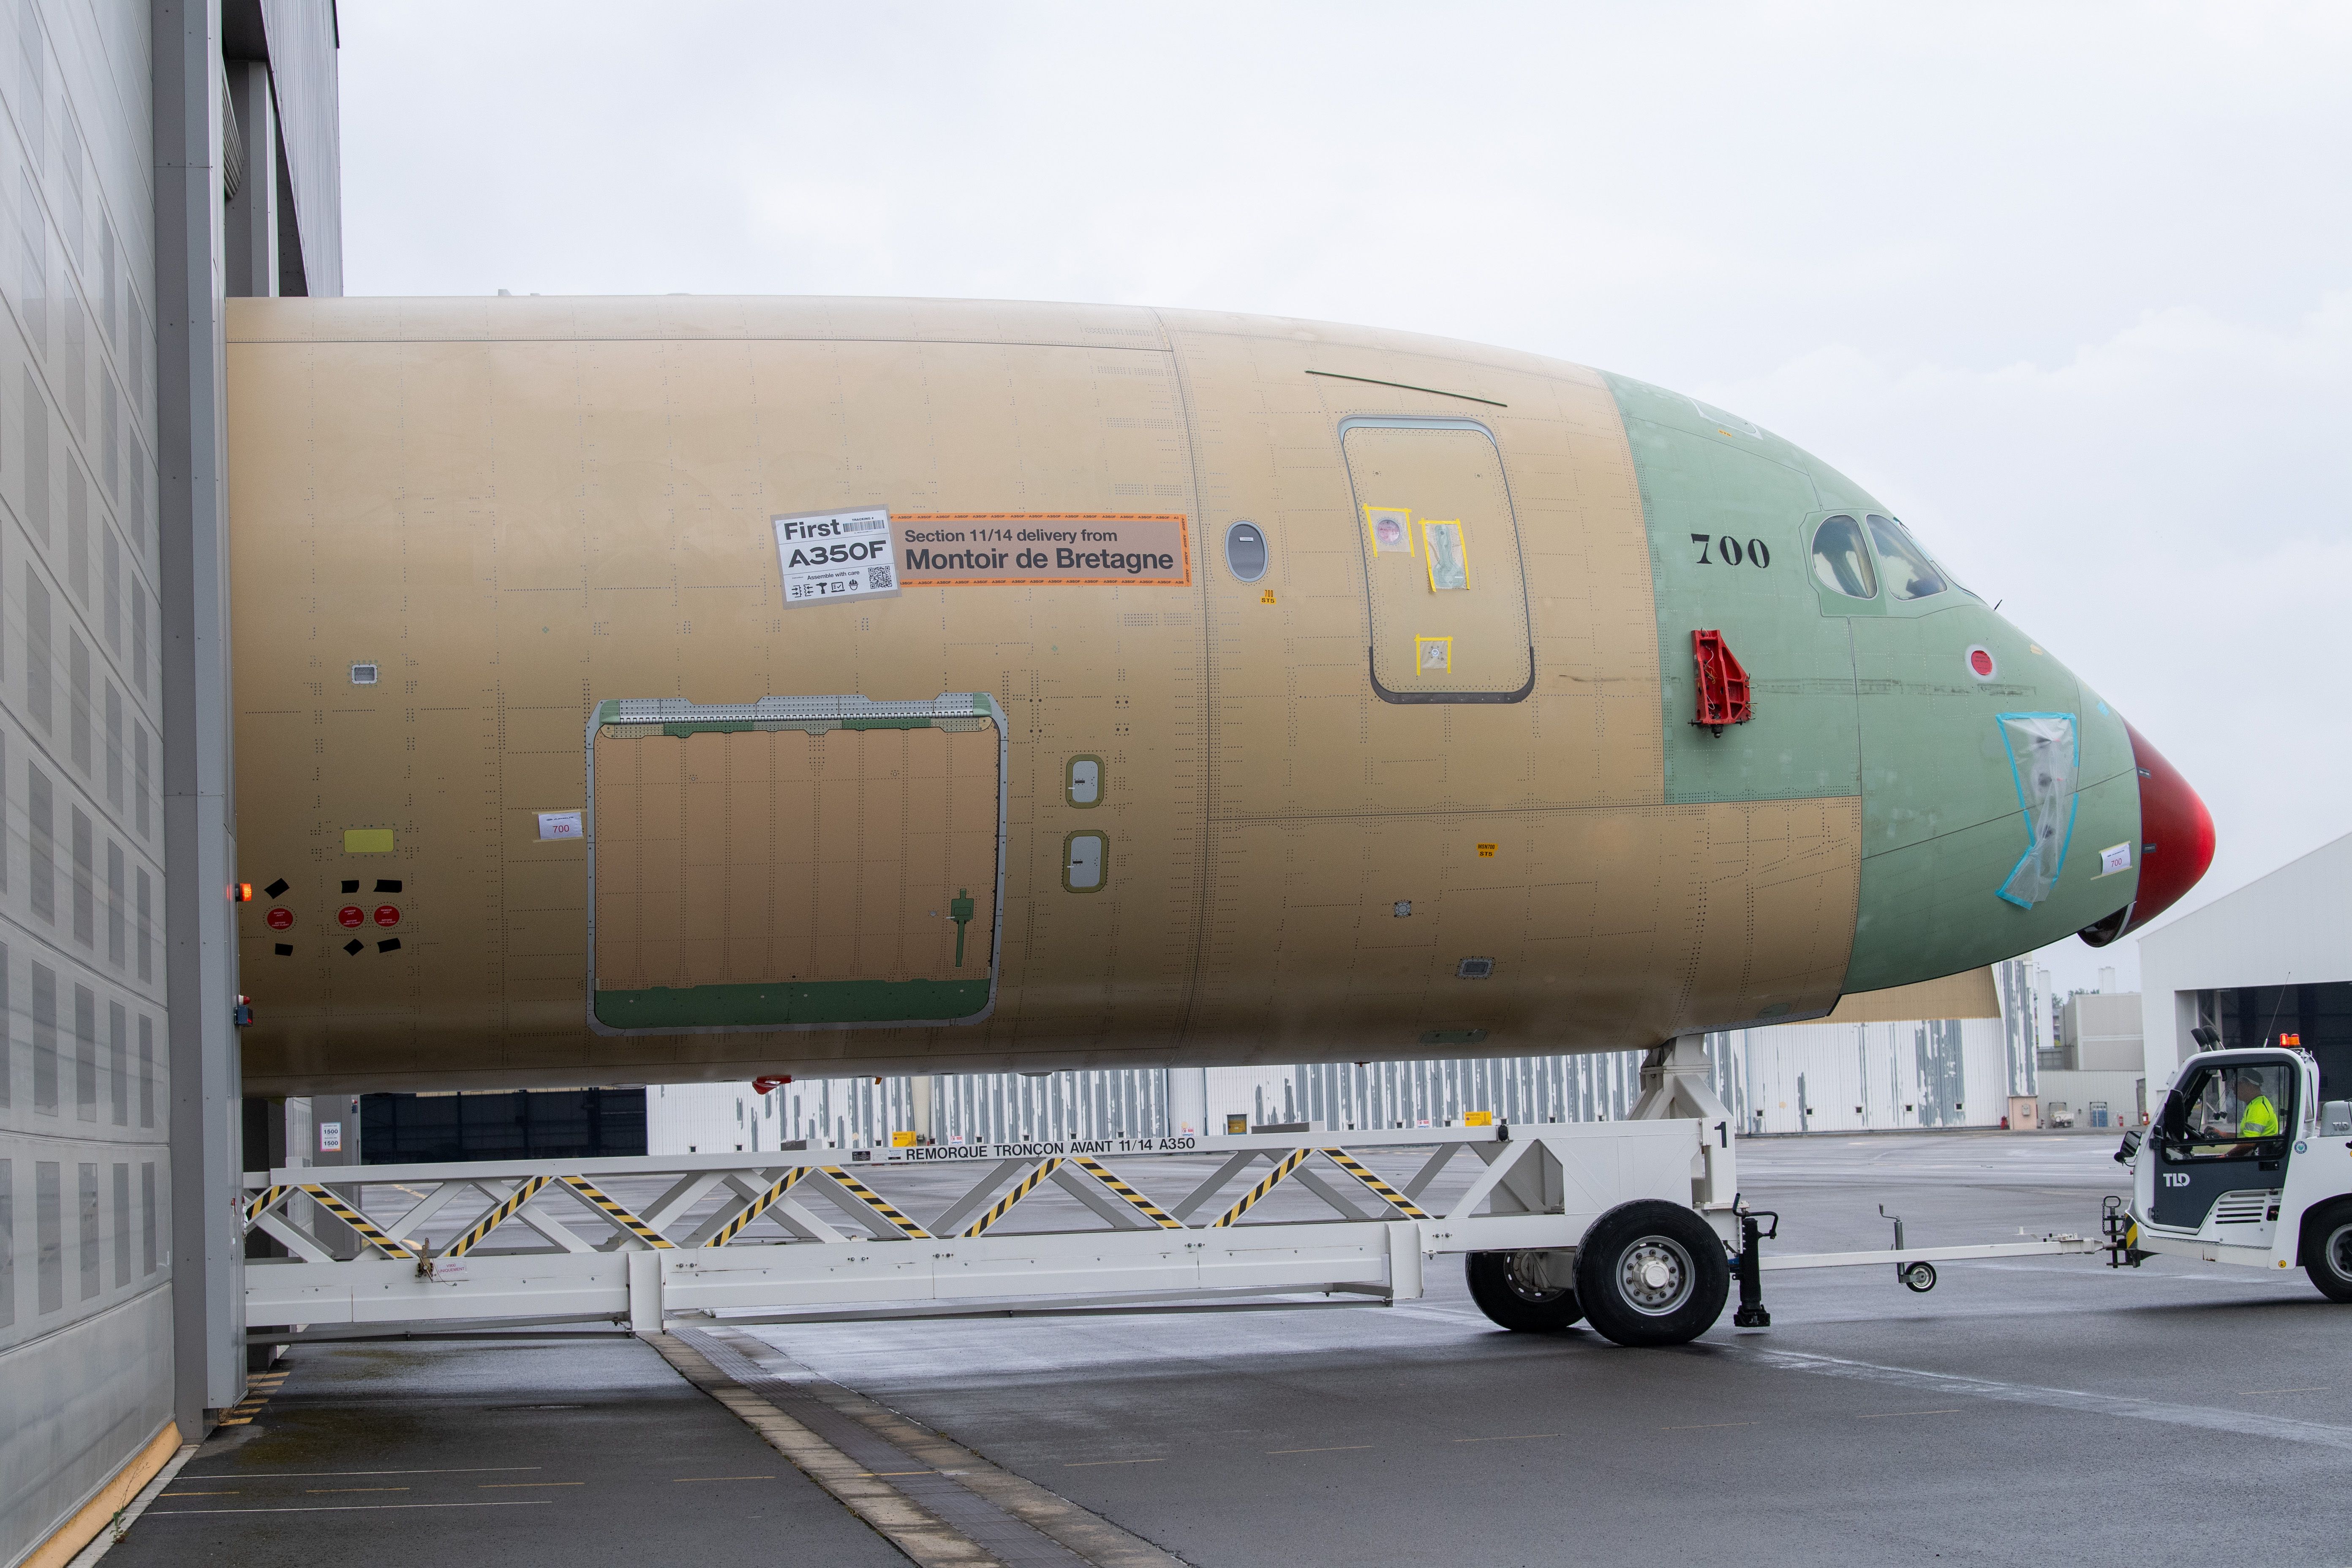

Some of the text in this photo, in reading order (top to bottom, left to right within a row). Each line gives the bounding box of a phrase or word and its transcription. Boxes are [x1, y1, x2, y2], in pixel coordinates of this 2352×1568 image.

[784, 519, 841, 540] First
[905, 529, 1117, 544] Section 11/14 delivery from
[788, 540, 886, 568] A350F
[1691, 534, 1769, 568] 700
[906, 548, 1173, 574] Montoir de Bretagne
[1265, 589, 1274, 598] 700
[553, 825, 569, 833] 700
[2111, 858, 2122, 868] 700
[1714, 1121, 1727, 1148] 1
[2333, 1122, 2349, 1131] TLD
[906, 1137, 1195, 1160] REMORQUE TRONÇON AVANT 11/14 A350
[2163, 1173, 2190, 1187] TLD
